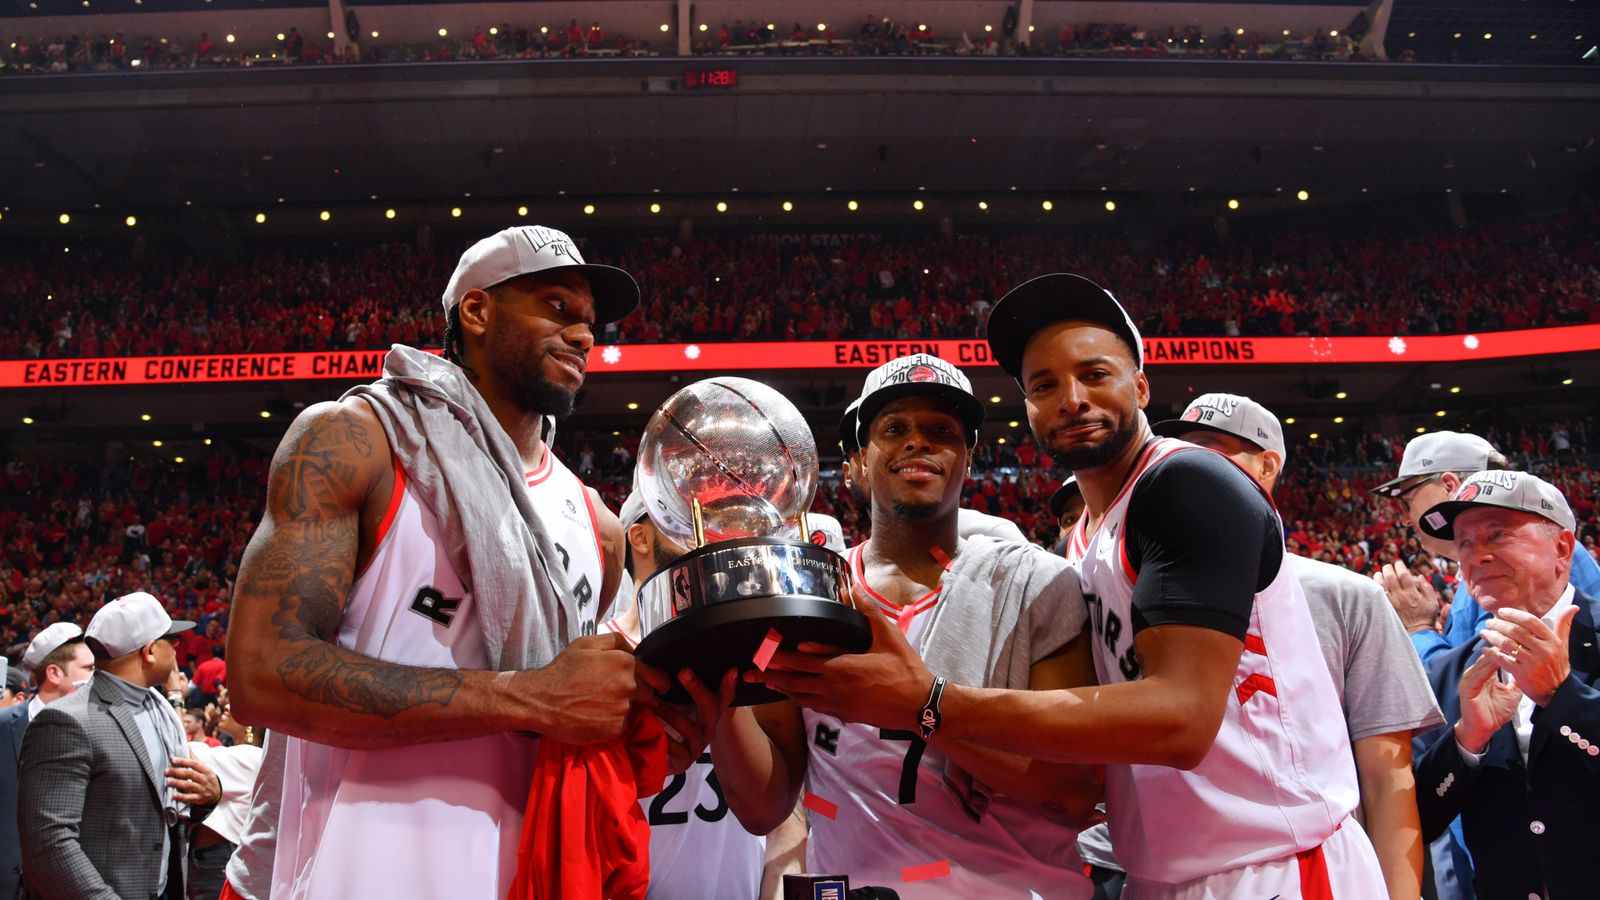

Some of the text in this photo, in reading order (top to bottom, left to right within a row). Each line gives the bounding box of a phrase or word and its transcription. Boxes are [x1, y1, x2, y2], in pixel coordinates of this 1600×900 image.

[521, 228, 564, 253] NBA
[958, 343, 996, 363] CO
[24, 361, 127, 383] EASTERN
[145, 356, 295, 380] CONFERENCE
[1202, 409, 1215, 421] 19
[1481, 485, 1494, 496] 19
[879, 727, 927, 804] 7
[648, 752, 729, 826] 23
